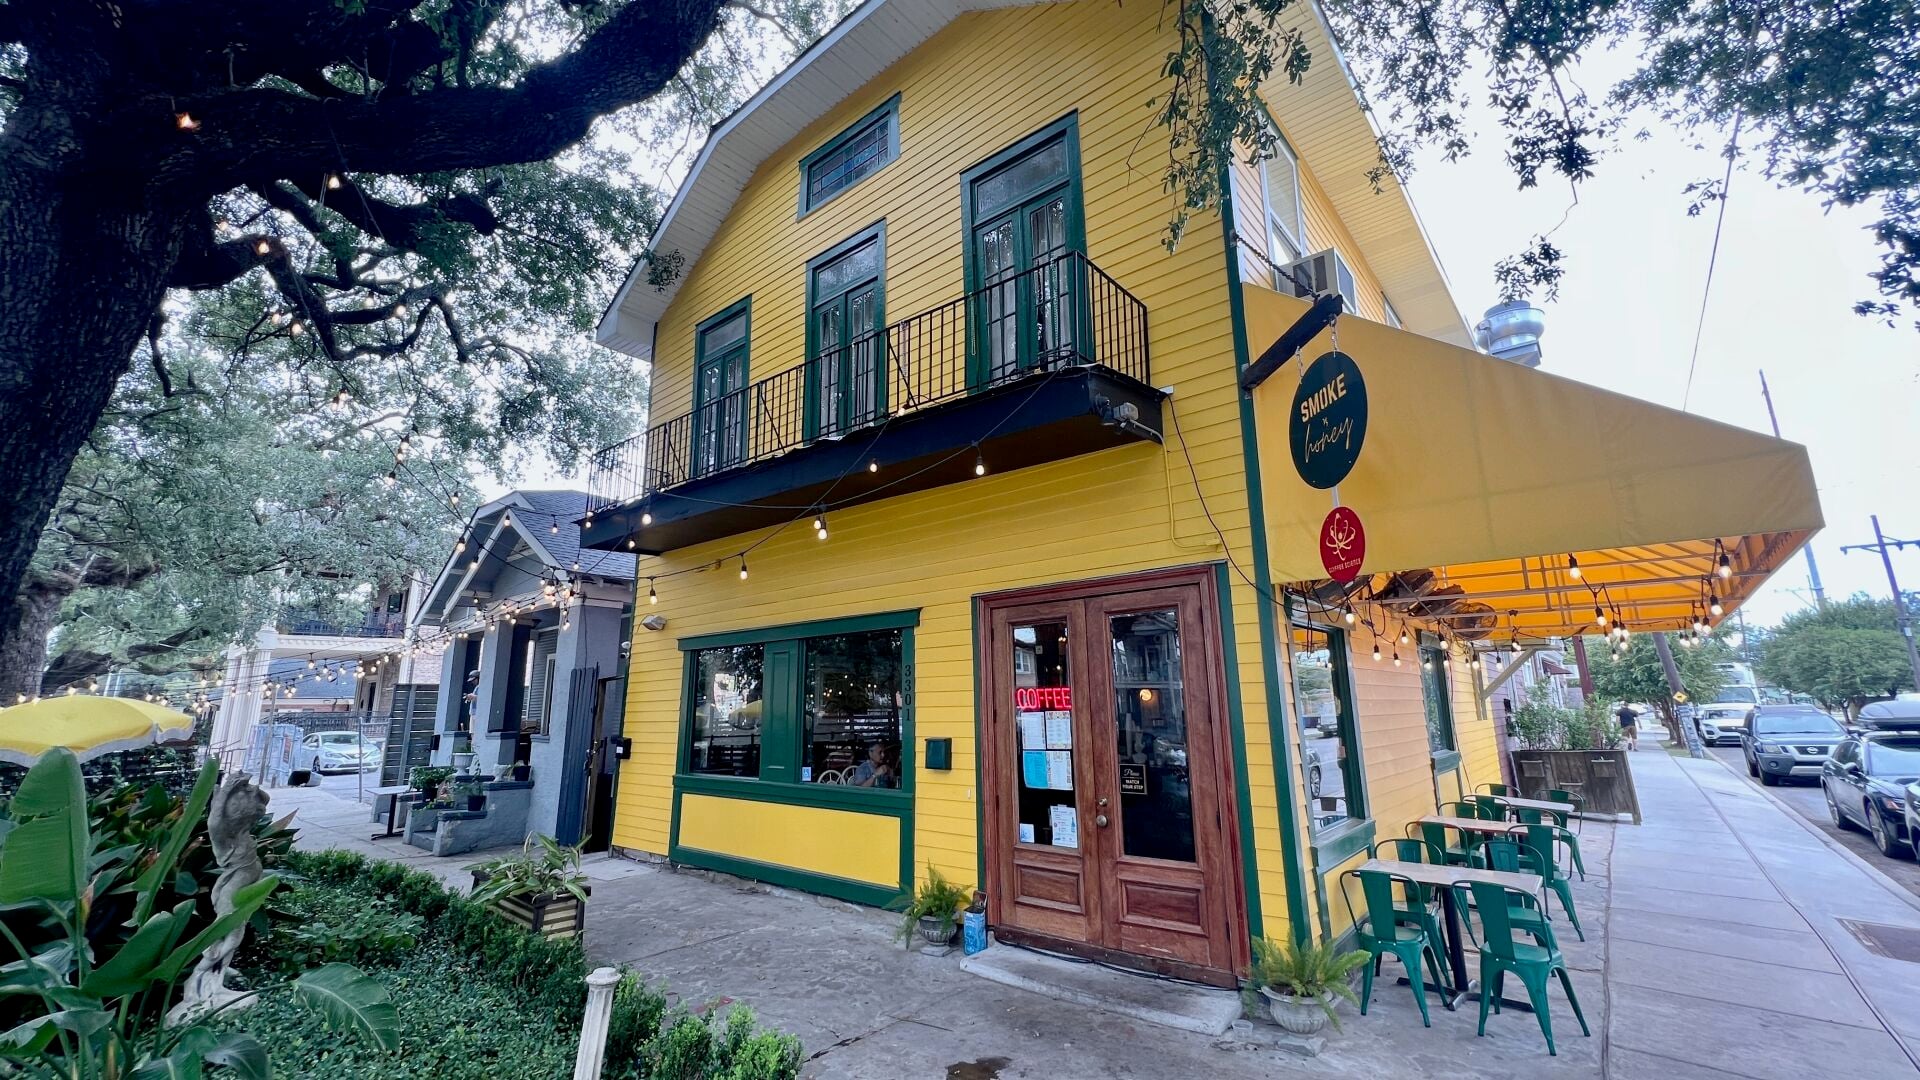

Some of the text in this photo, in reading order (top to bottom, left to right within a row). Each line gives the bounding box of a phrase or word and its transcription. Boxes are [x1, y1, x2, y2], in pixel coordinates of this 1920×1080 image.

[1301, 372, 1347, 423] SMOKE
[1305, 417, 1354, 463] honey
[1017, 687, 1072, 709] COFFEE
